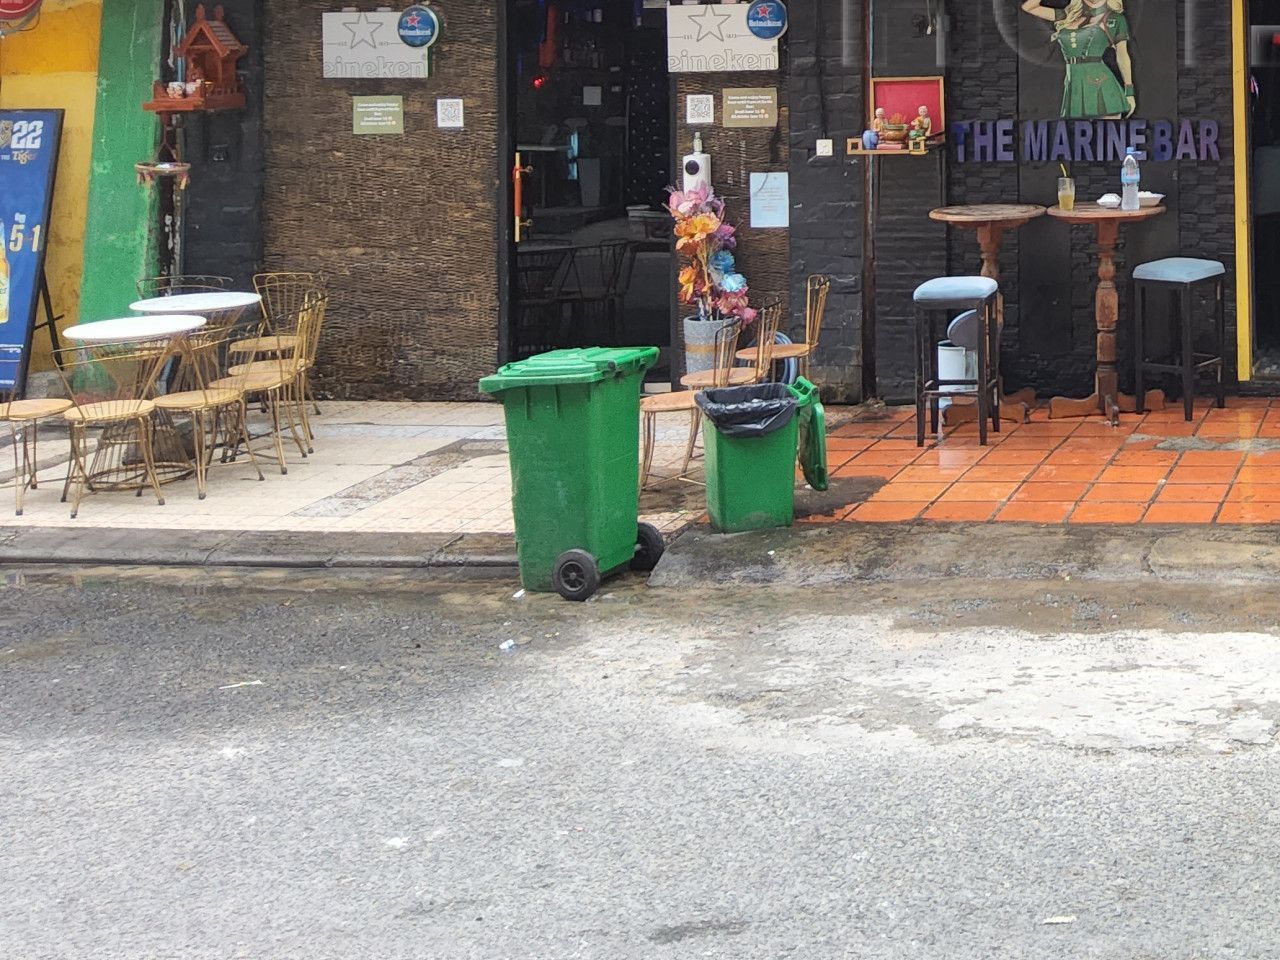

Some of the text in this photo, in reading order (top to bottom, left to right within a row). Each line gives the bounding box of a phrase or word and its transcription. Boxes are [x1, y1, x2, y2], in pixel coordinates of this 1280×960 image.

[953, 117, 1222, 162] THE MARINE BAR
